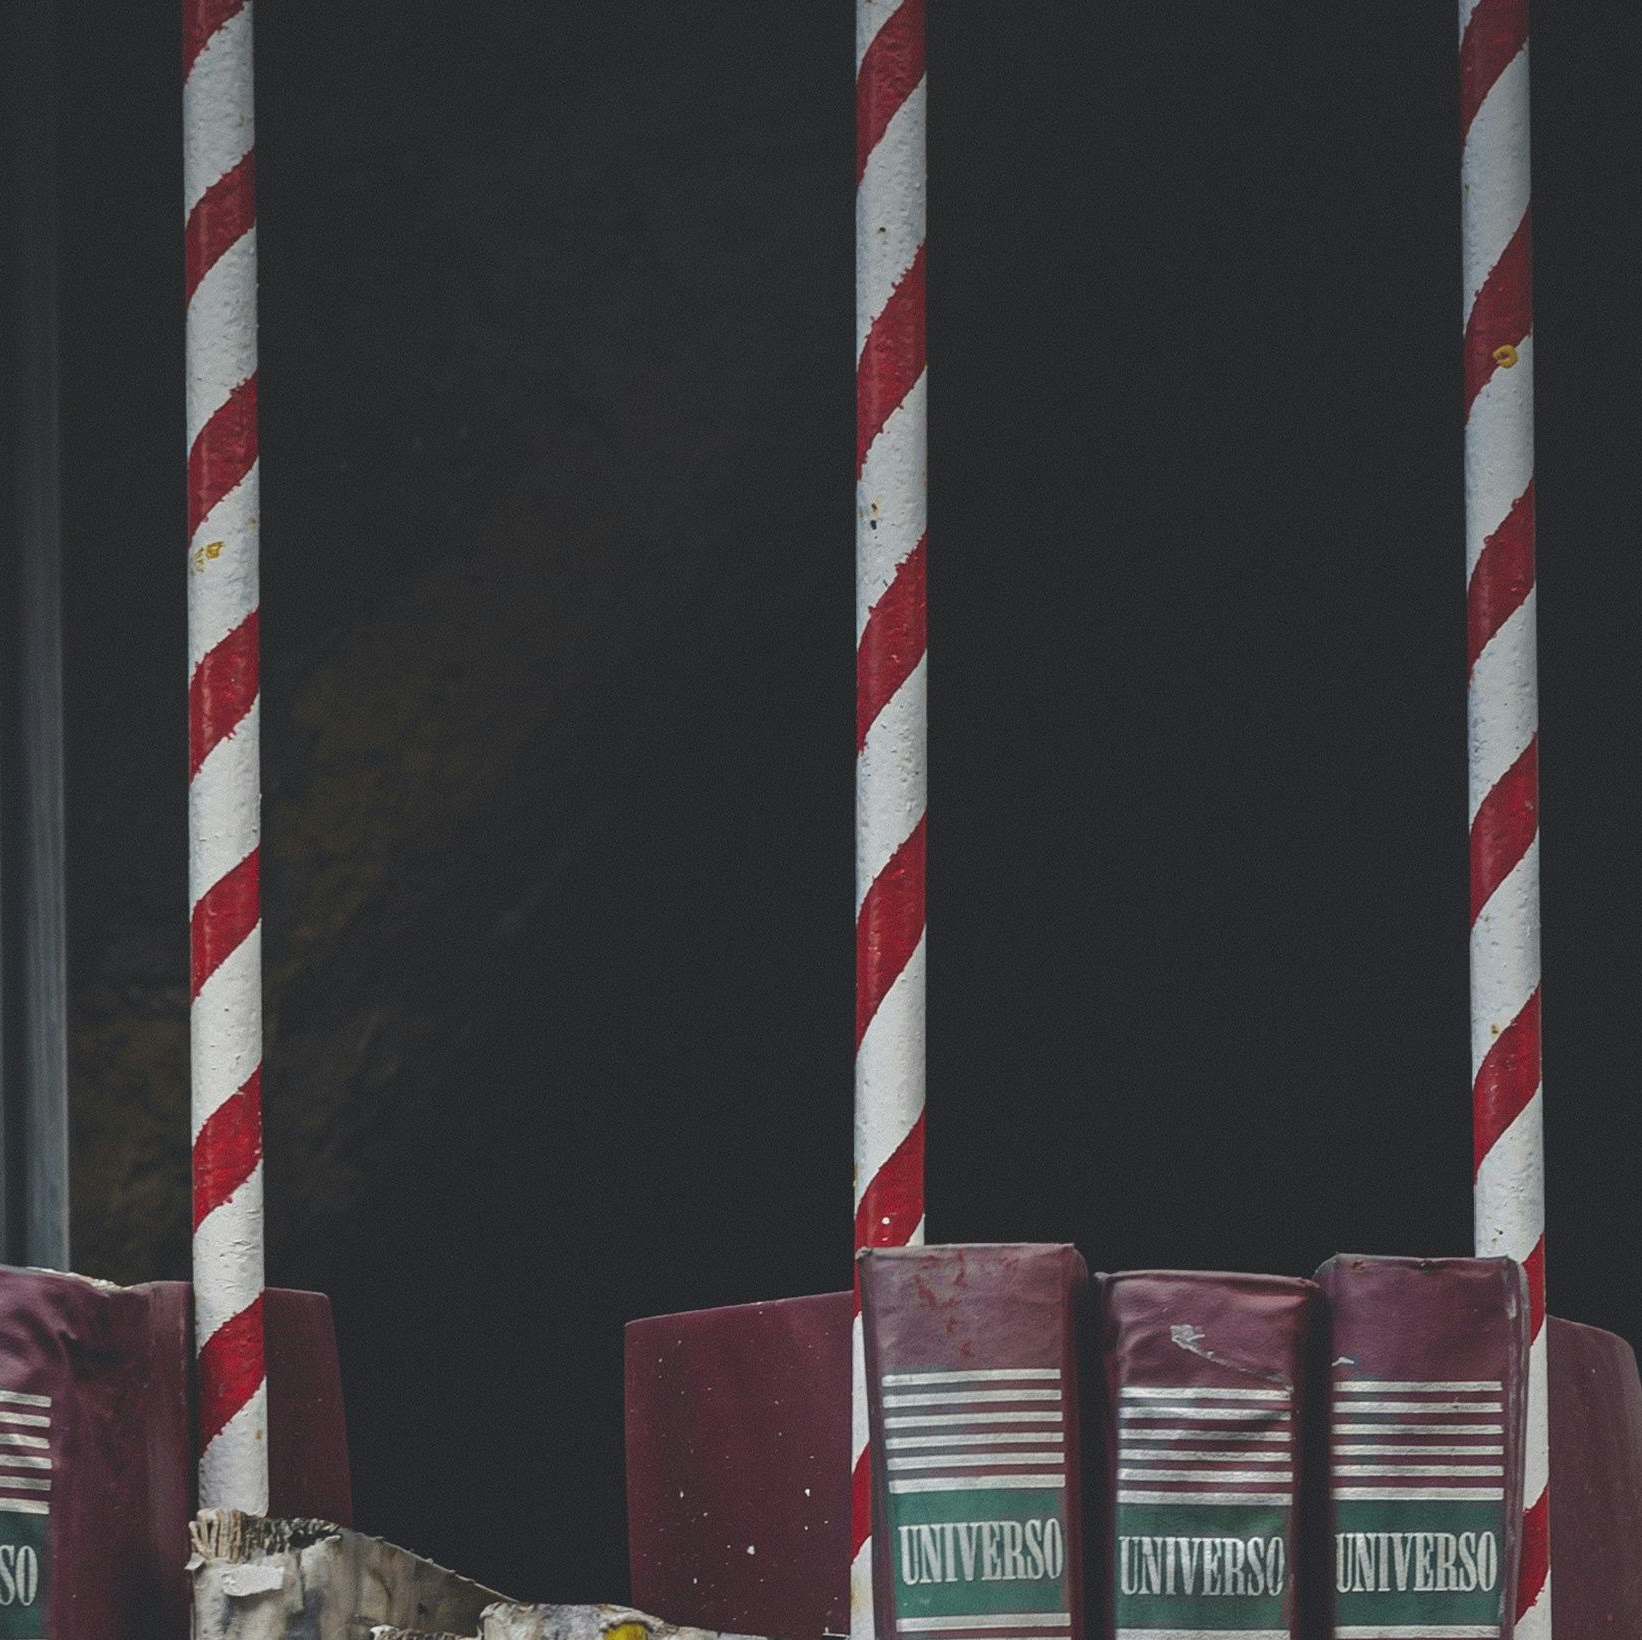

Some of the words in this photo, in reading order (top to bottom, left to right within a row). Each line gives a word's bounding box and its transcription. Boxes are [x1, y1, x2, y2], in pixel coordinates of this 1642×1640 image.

[899, 1517, 1063, 1585] UNIVERSO
[1119, 1535, 1285, 1596] UNIVERSO
[1335, 1530, 1497, 1593] UNIVERSO
